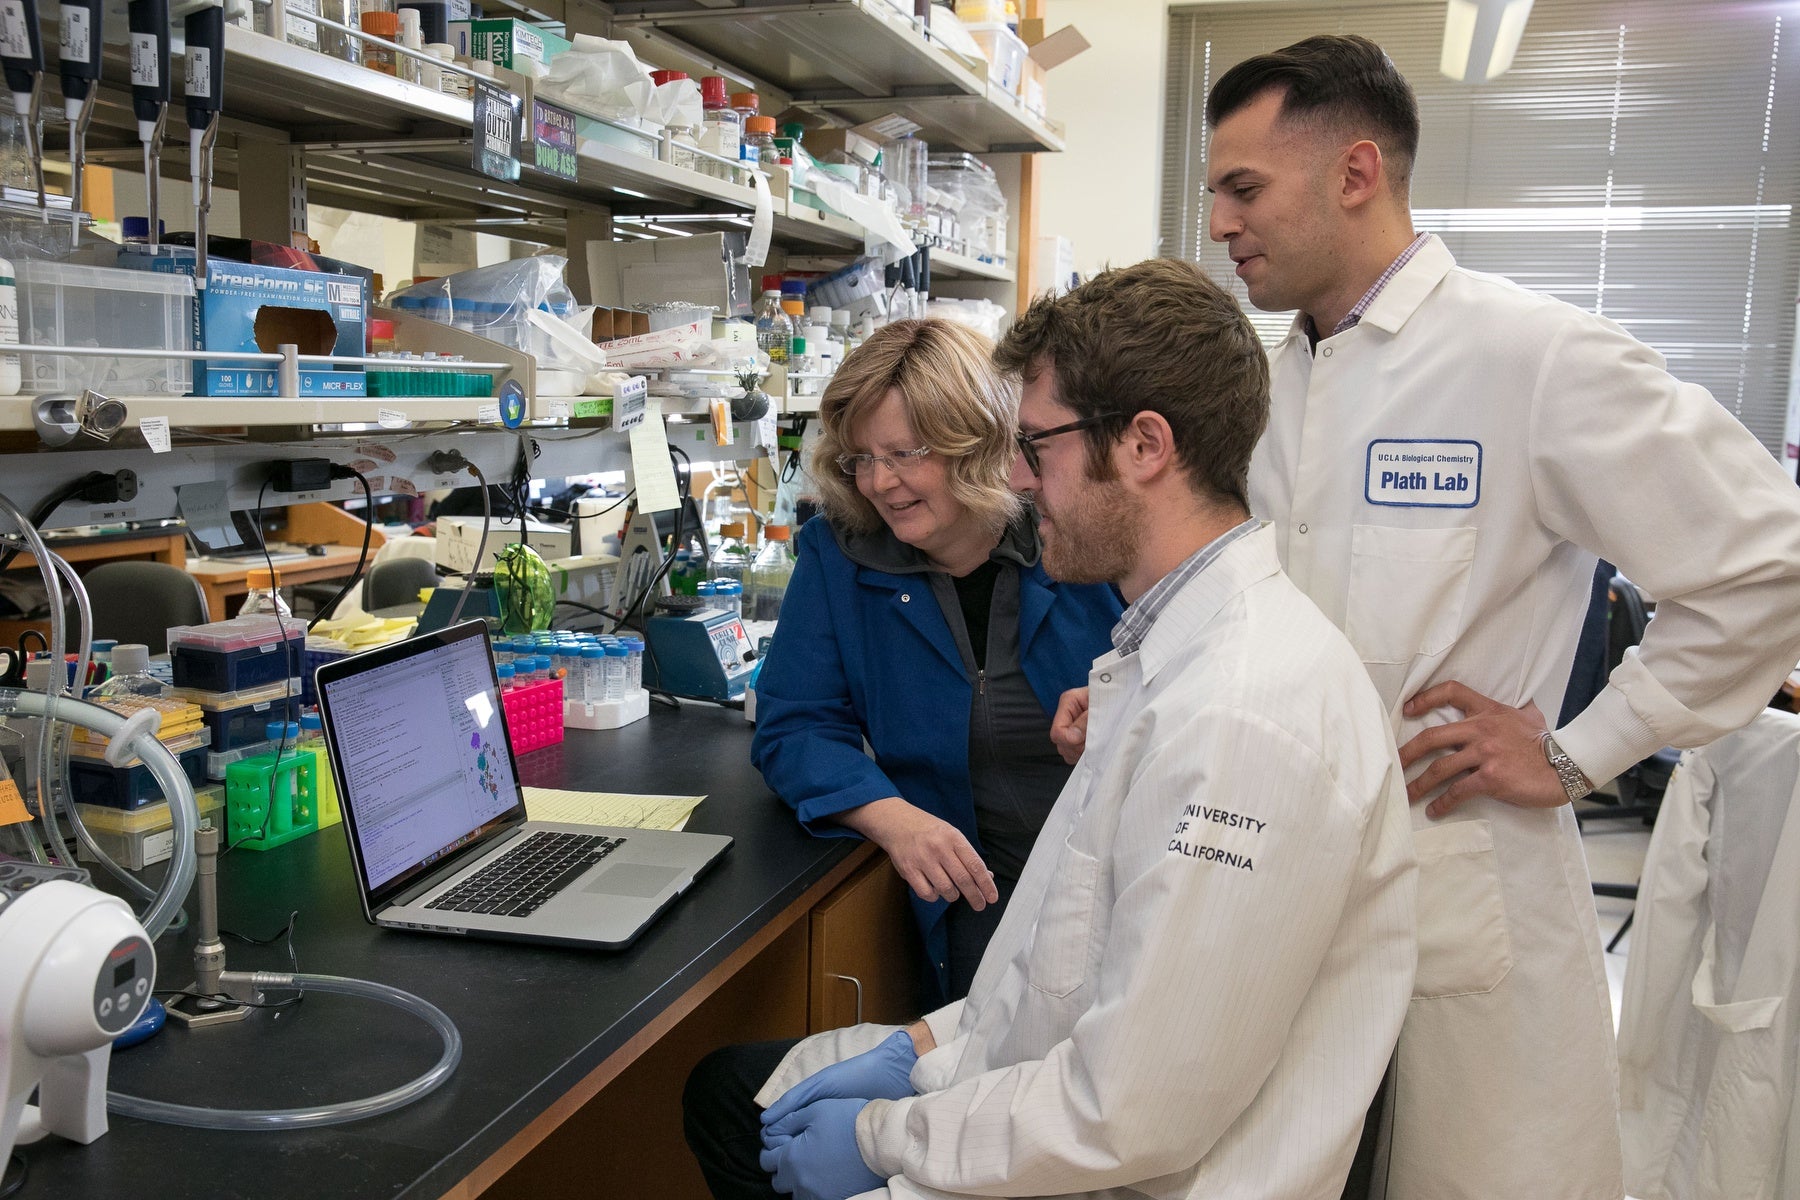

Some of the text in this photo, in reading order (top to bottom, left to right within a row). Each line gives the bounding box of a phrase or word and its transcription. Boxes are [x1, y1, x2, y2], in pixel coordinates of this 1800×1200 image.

[486, 112, 511, 143] OUTTA
[536, 144, 576, 177] DUMB ASS
[210, 268, 299, 293] FreeForm
[303, 279, 324, 297] SE
[328, 283, 341, 302] M
[322, 381, 364, 391] MICROFLEX
[1378, 453, 1474, 465] UCLA Biological Chemistry
[1381, 471, 1469, 491] Plath Lab
[734, 624, 745, 640] 2
[1175, 821, 1190, 834] OF
[1168, 839, 1253, 871] CALIFORNIA
